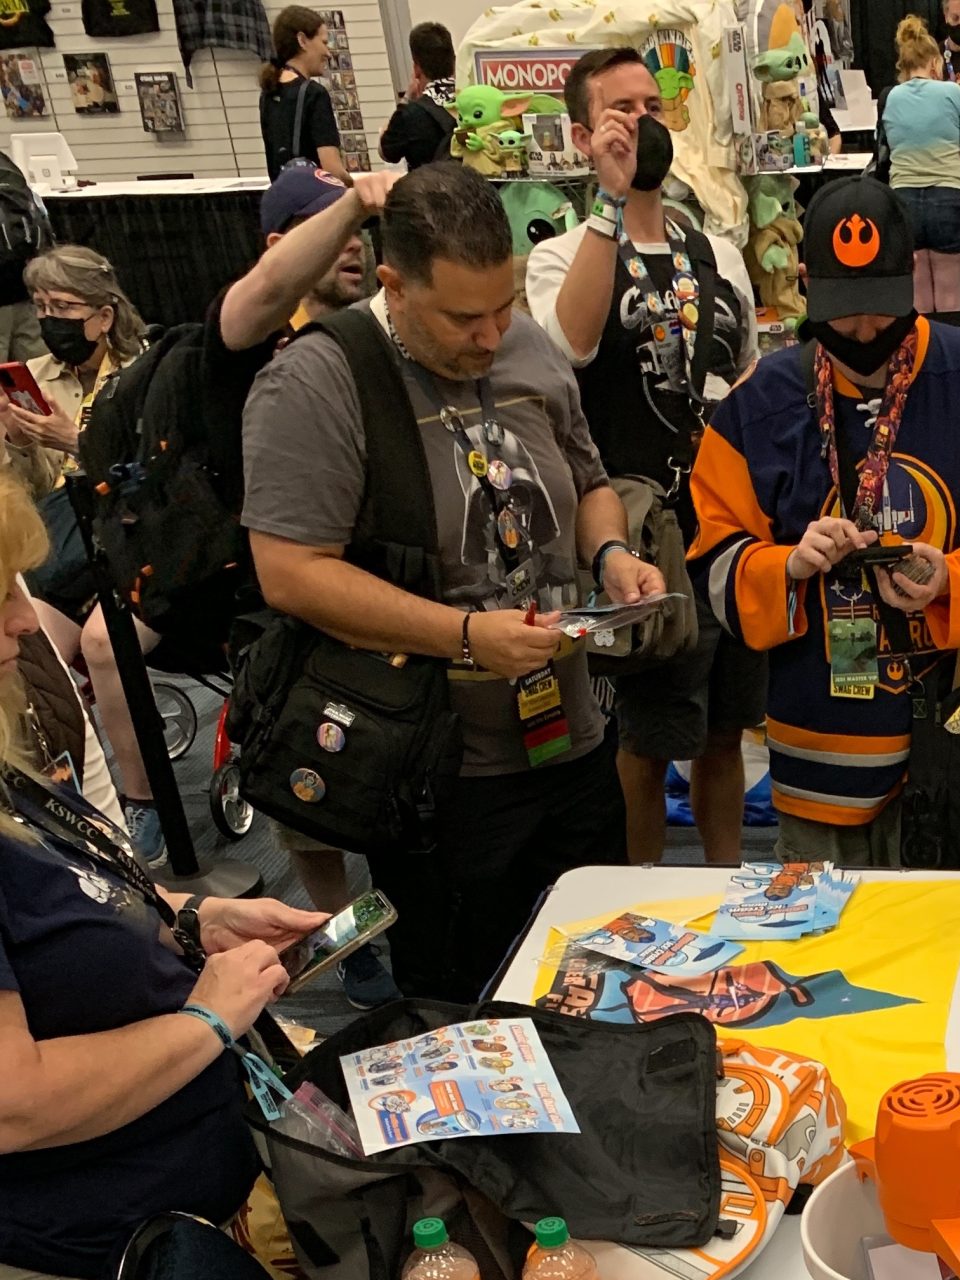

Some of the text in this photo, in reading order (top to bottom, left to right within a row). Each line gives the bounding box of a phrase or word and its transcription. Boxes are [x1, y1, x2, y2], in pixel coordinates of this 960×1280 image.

[485, 62, 571, 87] MONOPO
[833, 685, 871, 696] SWAG CREW
[44, 798, 99, 839] KSWCC
